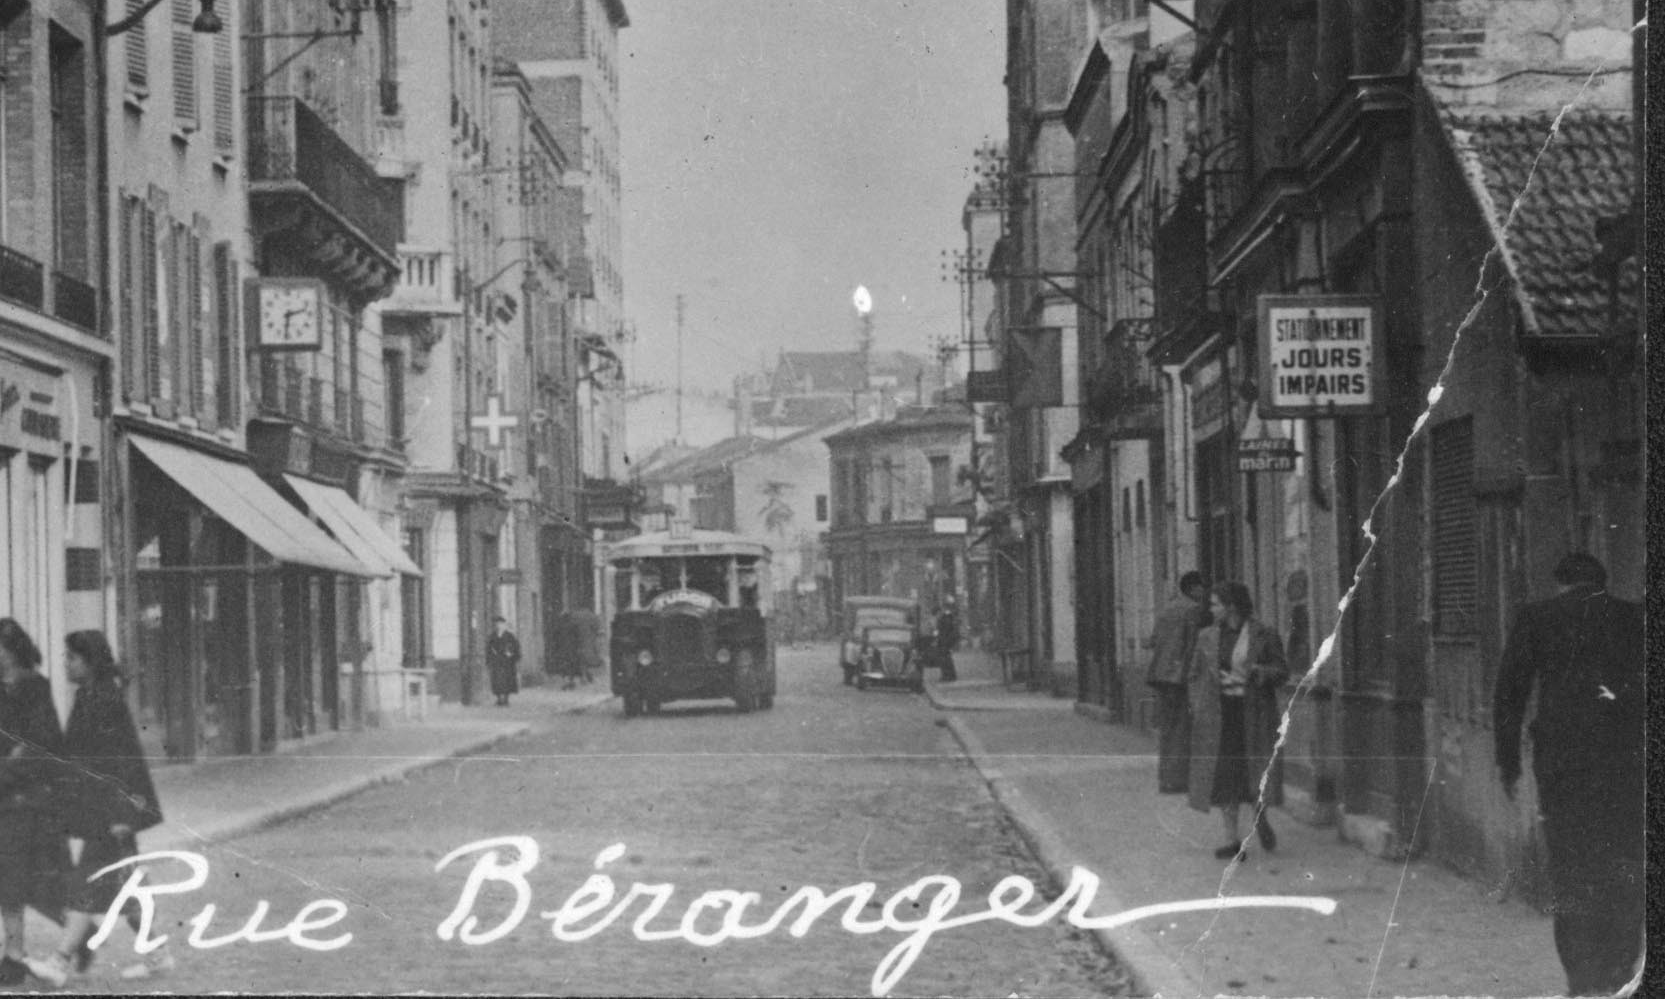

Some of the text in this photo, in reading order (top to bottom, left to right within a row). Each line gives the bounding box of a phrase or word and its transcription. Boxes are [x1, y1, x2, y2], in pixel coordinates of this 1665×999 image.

[1277, 317, 1366, 342] STATIONNEMENT
[1281, 347, 1361, 369] JOURS
[1279, 374, 1365, 395] IMPAIRS
